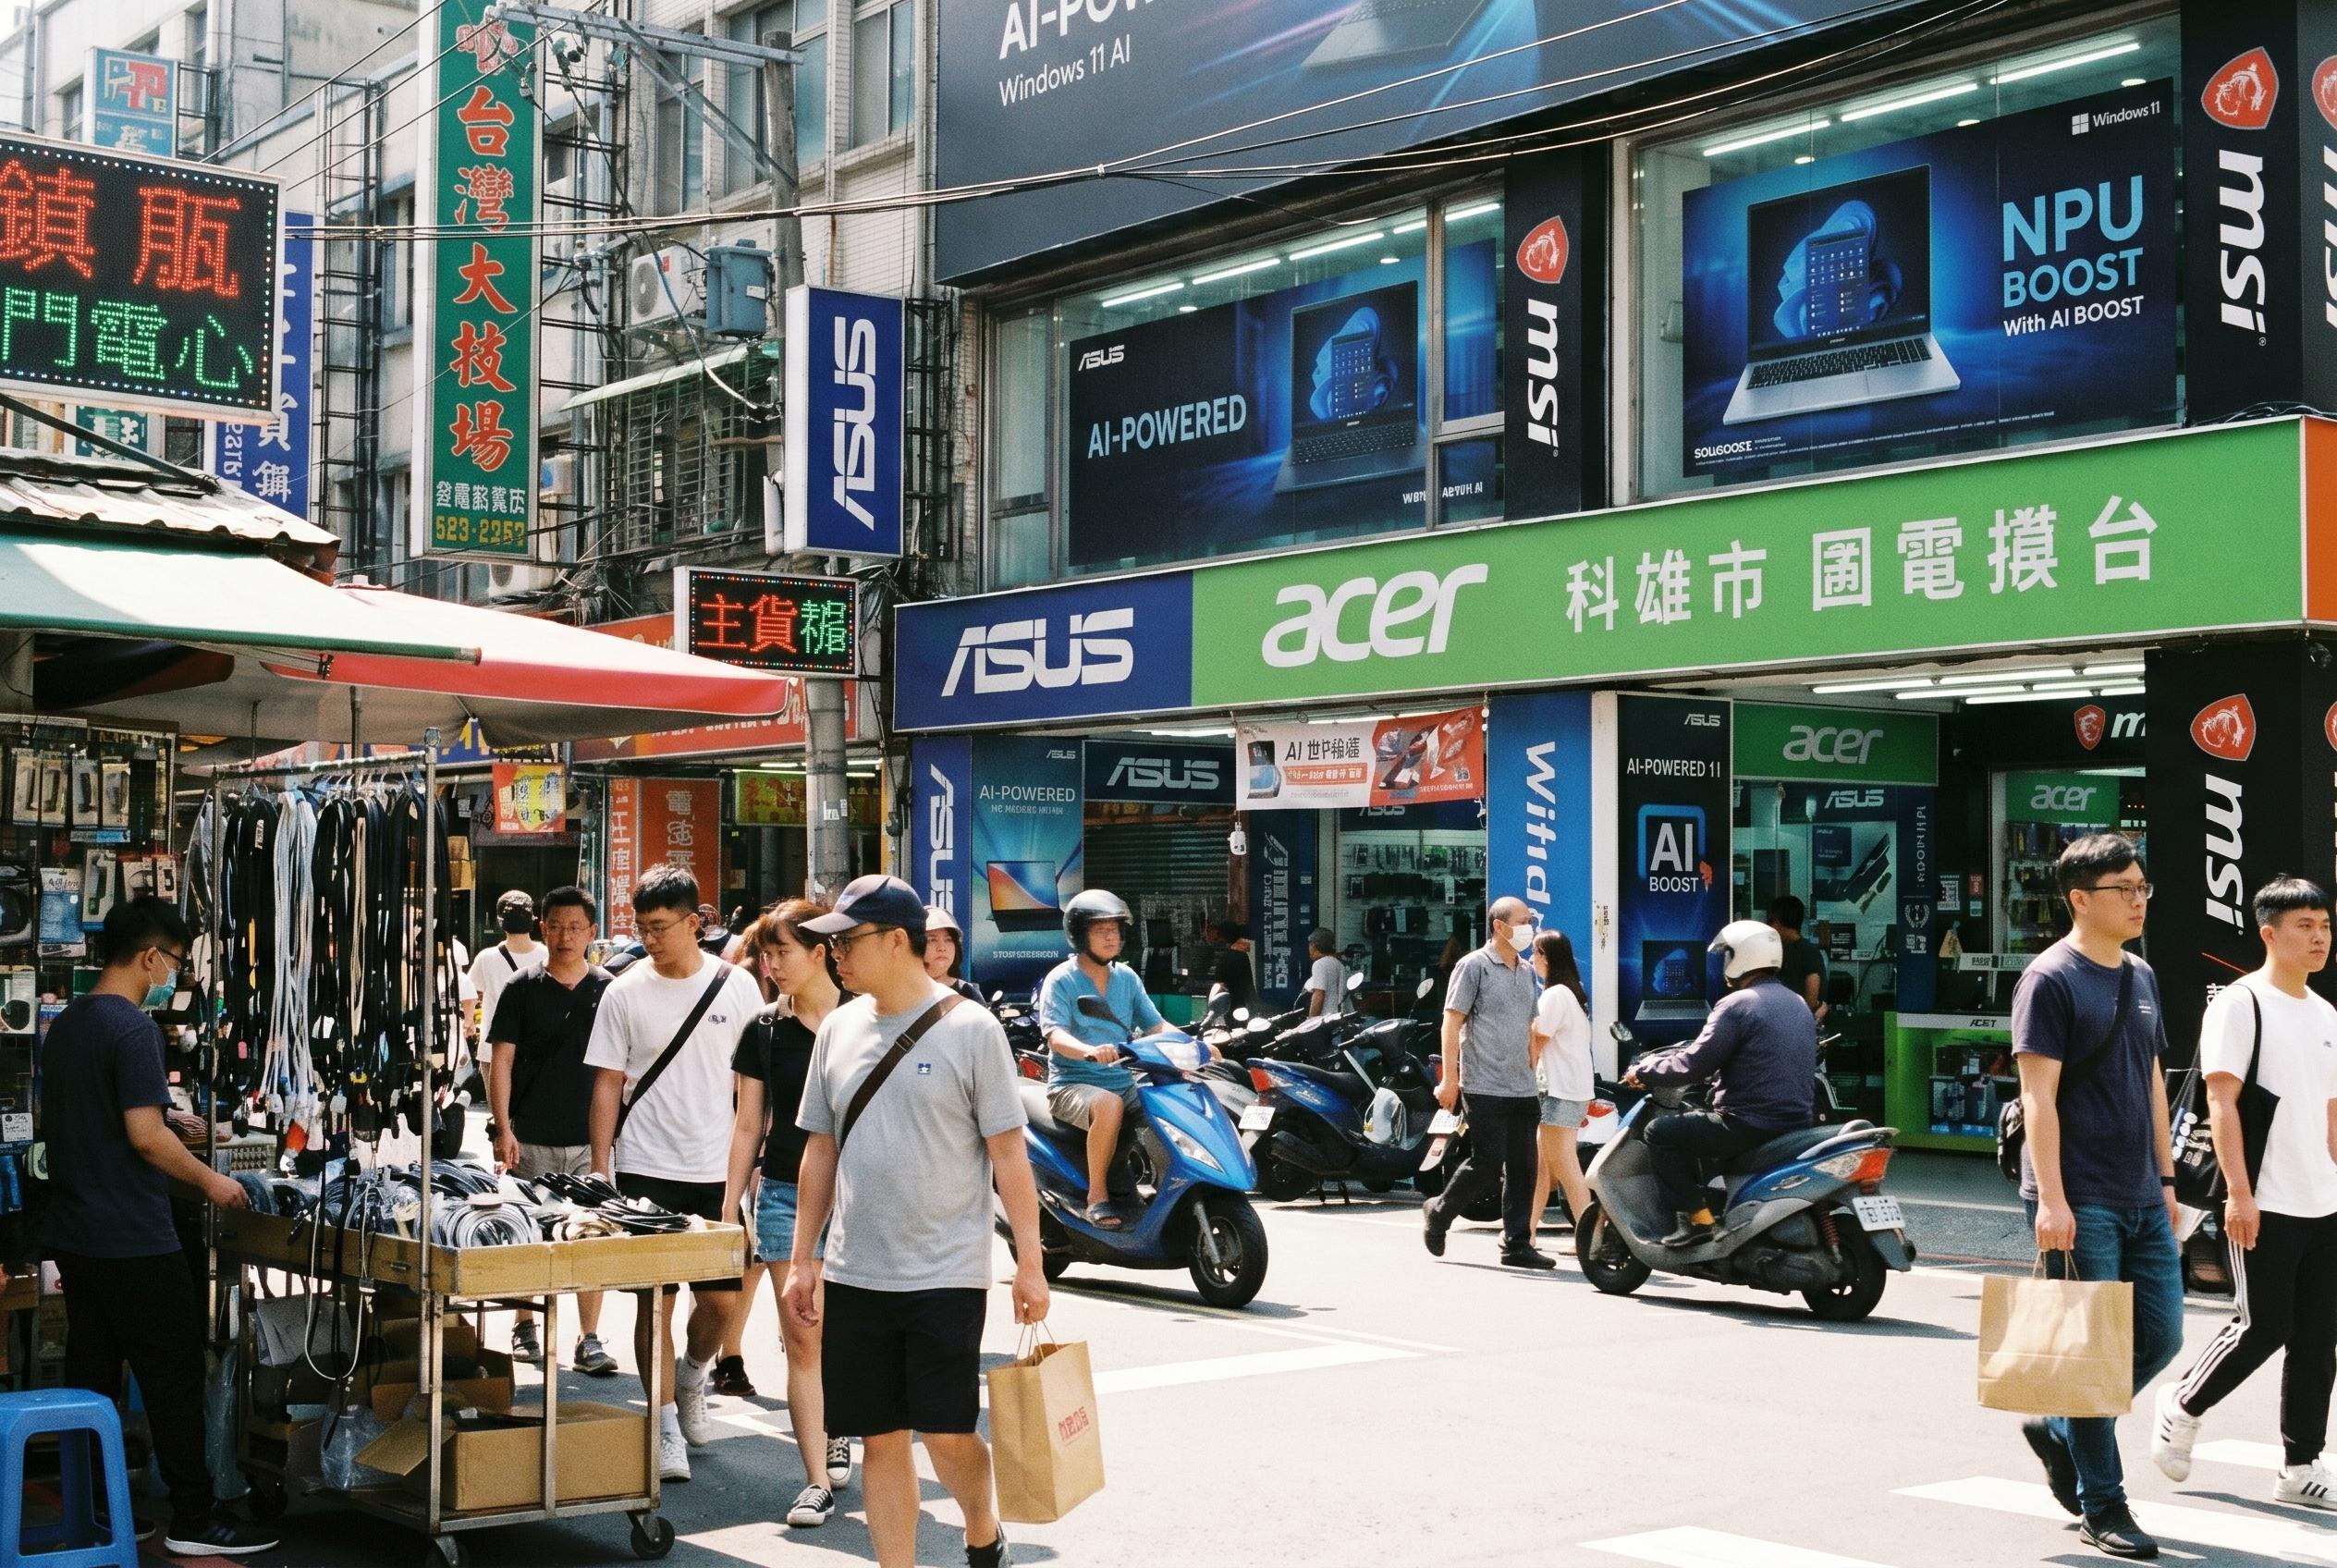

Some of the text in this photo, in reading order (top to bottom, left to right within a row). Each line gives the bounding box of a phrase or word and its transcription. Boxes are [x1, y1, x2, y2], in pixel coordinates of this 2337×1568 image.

[998, 33, 1130, 106] Windows 11 AI
[2093, 101, 2161, 128] Windows 11
[2002, 174, 2143, 262] NPU
[2220, 149, 2266, 335] msi
[2003, 248, 2143, 308] BOOST
[2003, 296, 2143, 337] With AI BOOST
[1078, 345, 1125, 372] ASUS
[1527, 298, 1559, 448] msi
[834, 317, 875, 532] ASUS
[1087, 394, 1247, 459] AI-POWERED
[1262, 562, 1488, 668] acer
[941, 607, 1133, 697] ASUS
[1683, 714, 1720, 727] ASUS
[1285, 741, 1302, 761] AI
[1782, 725, 1883, 765] acer
[1107, 756, 1219, 790] ASUS
[1627, 757, 1706, 778] AI-POWERED
[980, 785, 1076, 802] AI-POWERED
[1825, 790, 1884, 809] ASUS
[2030, 784, 2097, 812] acer
[1649, 822, 1694, 872] AI
[2206, 773, 2245, 929] msi
[1649, 877, 1699, 892] BOOST
